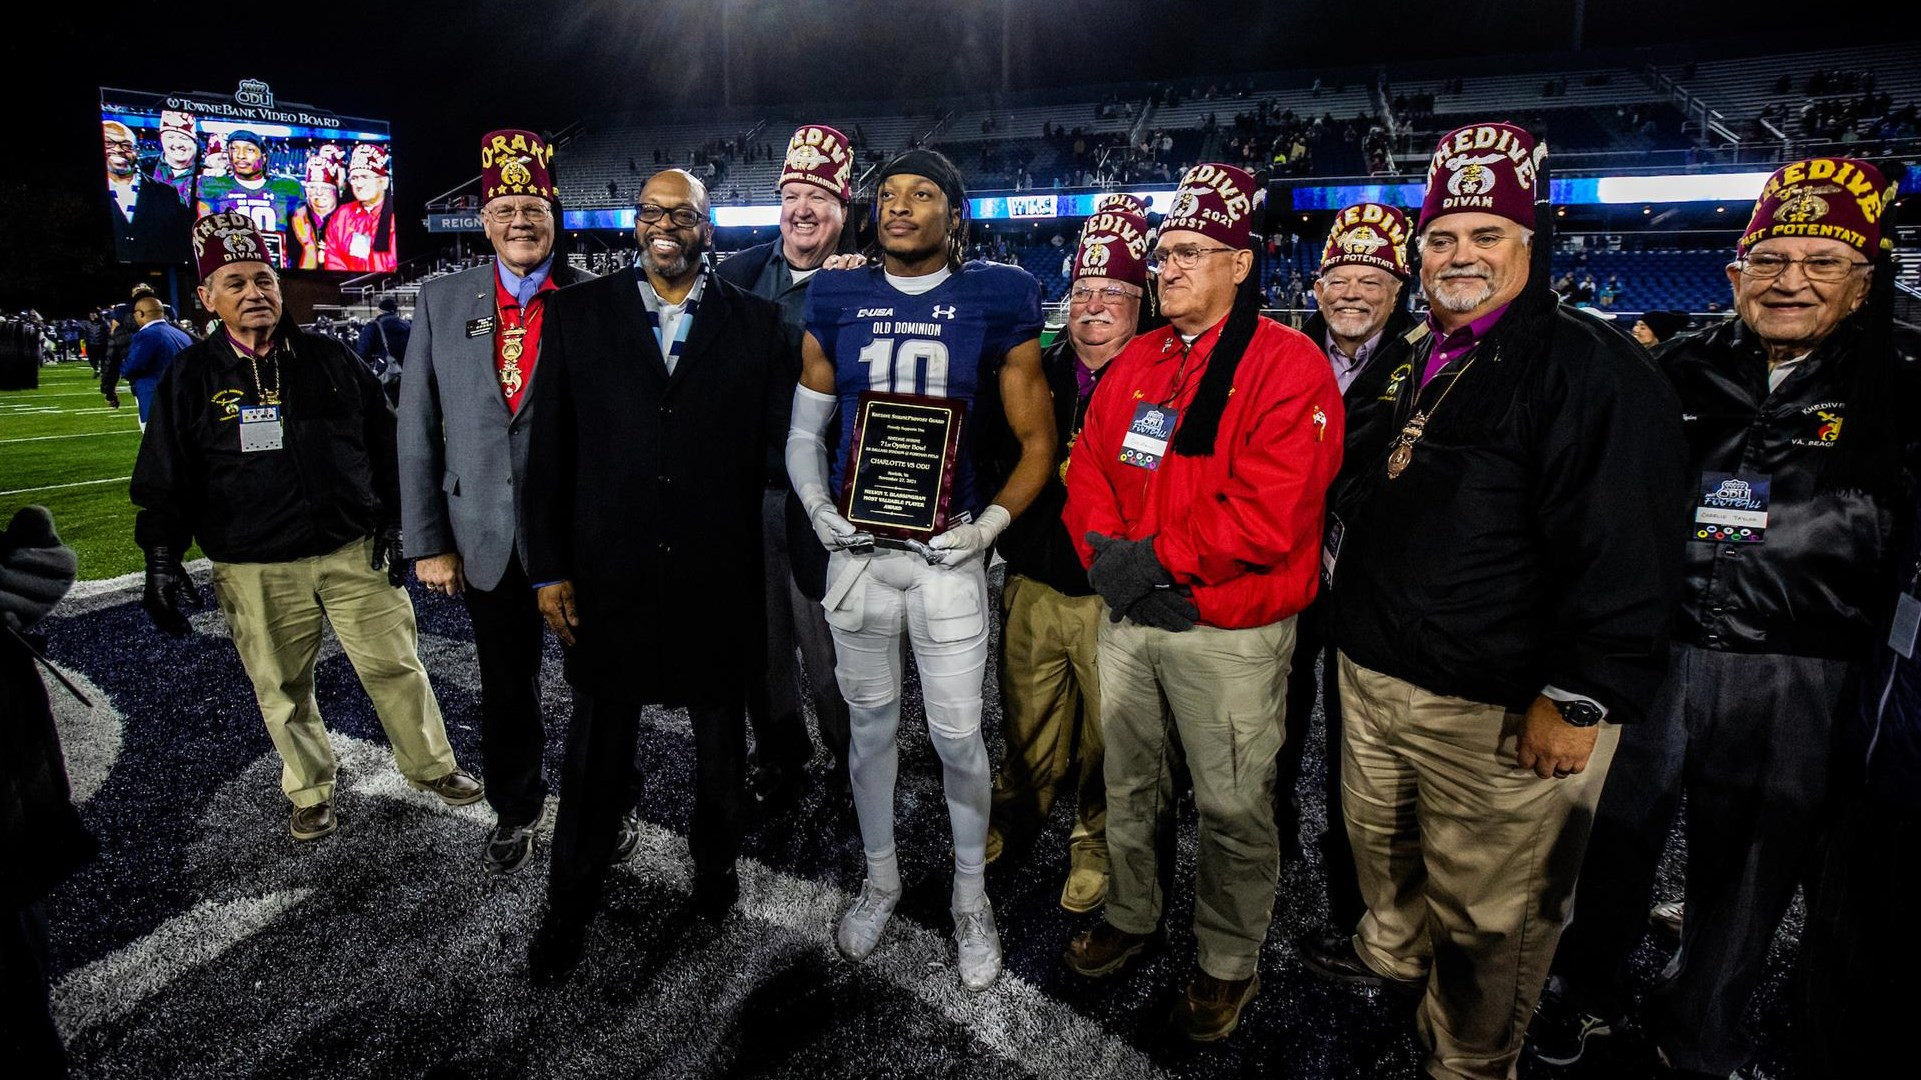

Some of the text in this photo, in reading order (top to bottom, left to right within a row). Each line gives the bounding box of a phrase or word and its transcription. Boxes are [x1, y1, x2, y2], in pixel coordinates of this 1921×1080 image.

[237, 91, 272, 106] ODU
[257, 108, 297, 123] VIDEO
[299, 112, 340, 128] BOARD
[784, 127, 850, 190] EDIVE
[1426, 126, 1537, 197] KHEDIVE
[1177, 164, 1251, 222] EDIVE
[1442, 196, 1494, 208] DIVAN
[441, 218, 482, 228] REIGN
[1160, 217, 1207, 230] OVOST
[1201, 208, 1233, 229] 2021
[192, 212, 254, 258] KHEDI
[1080, 213, 1147, 260] EDIVE
[1740, 223, 1867, 248] AST POTENTATE
[223, 252, 262, 262] DIVAN
[1323, 254, 1395, 270] AST POTENTATE
[1079, 267, 1107, 276] DIVAN
[872, 321, 942, 337] OLD DOMINION
[858, 337, 950, 397] 10
[870, 457, 906, 468] CHARLOTTE
[1719, 489, 1749, 500] ODU
